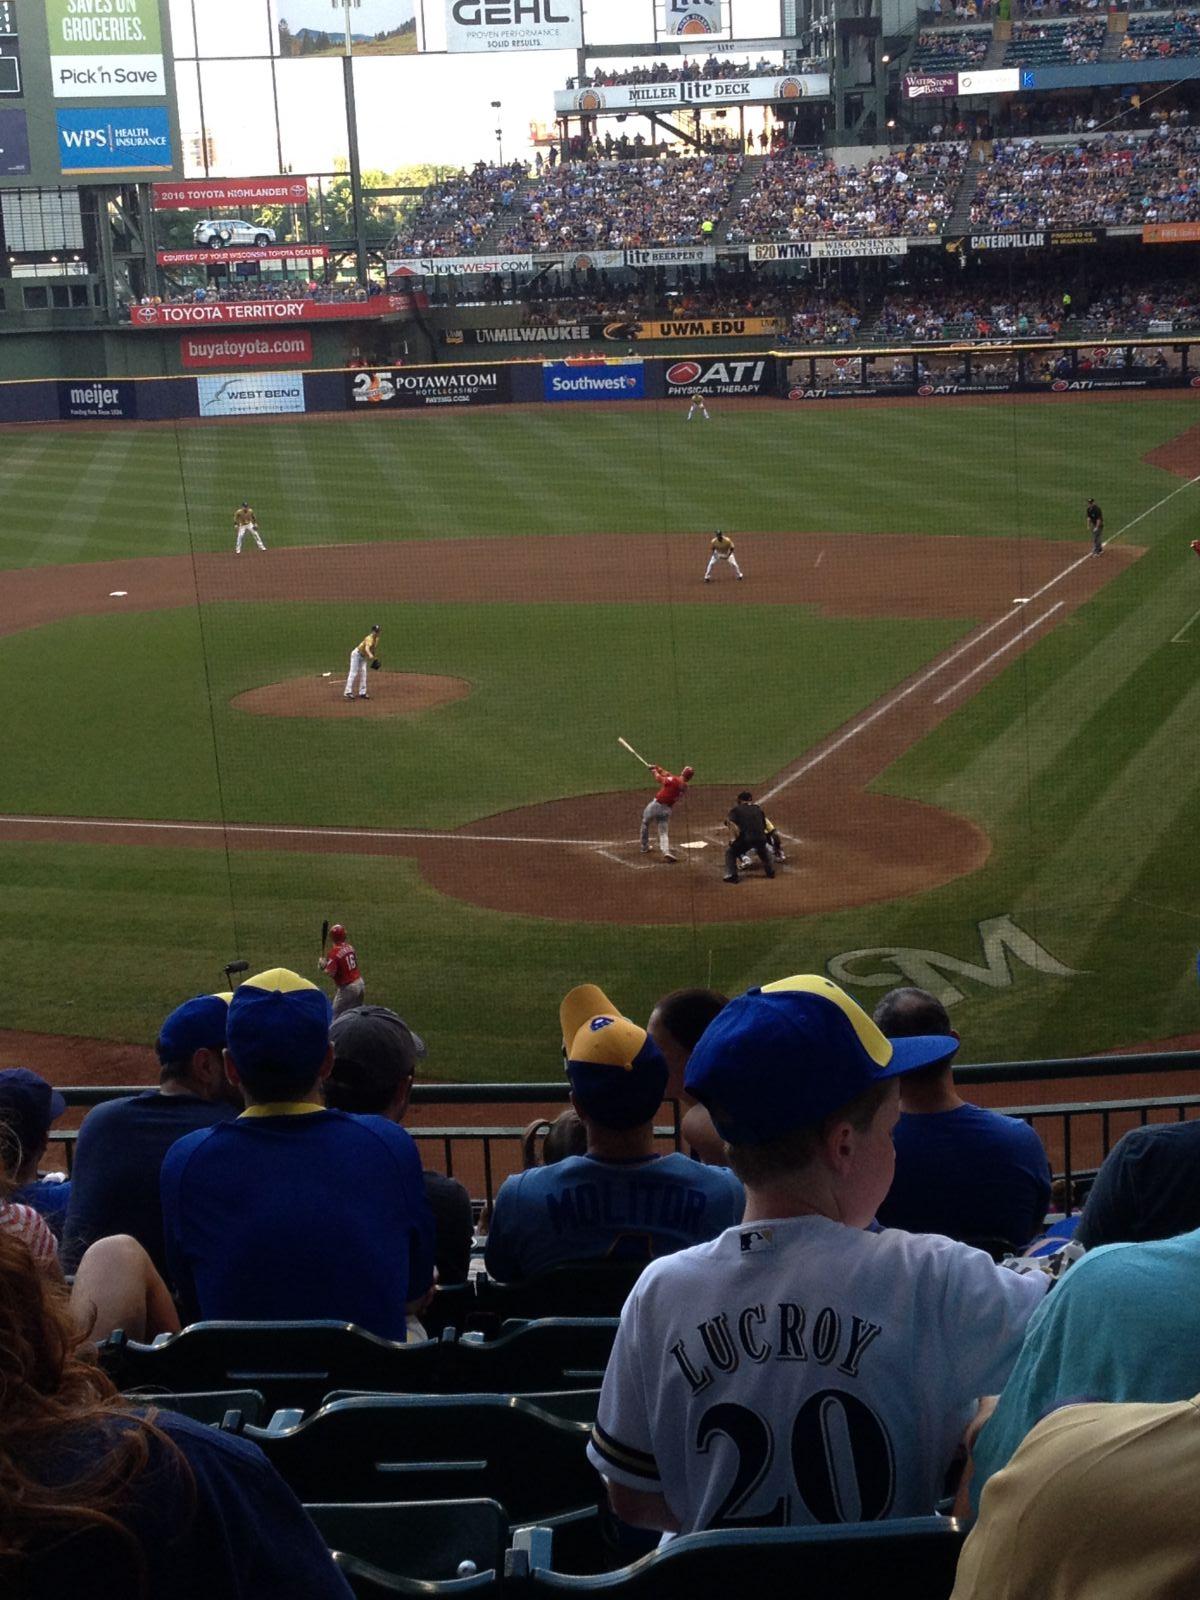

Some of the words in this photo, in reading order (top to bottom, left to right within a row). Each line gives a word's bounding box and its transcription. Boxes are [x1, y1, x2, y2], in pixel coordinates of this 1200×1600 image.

[452, 0, 570, 25] GEHL
[62, 17, 147, 41] GROCERIES.
[466, 31, 499, 39] PROVEN
[501, 28, 560, 37] PERFORMANCE
[487, 39, 509, 48] SOLID
[60, 69, 97, 84] Pick
[114, 68, 158, 83] Save
[629, 88, 677, 100] MILLER
[714, 83, 751, 96] DECK
[62, 129, 107, 148] WPS
[114, 127, 149, 138] HEALTH
[116, 136, 167, 147] INSURANCE
[161, 191, 185, 200] 2016
[187, 189, 225, 199] TOYOTA
[227, 187, 288, 197] HIGHLANDER
[824, 239, 895, 249] WISCONSIN'S
[971, 233, 1045, 249] CATERPILLAR
[163, 253, 199, 262] COURTESY
[652, 250, 696, 261] BEERPEN
[755, 245, 776, 259] 620
[777, 243, 812, 259] WTMJ
[818, 248, 851, 257] RADIO
[853, 245, 901, 256] STATION
[161, 306, 223, 321] TOYOTA
[225, 303, 304, 318] TERRITORY
[660, 320, 745, 336] UWM.EDU
[188, 339, 305, 359] buyatoyota.com
[699, 361, 765, 383] ATI
[396, 373, 497, 389] POTAWATOMI
[552, 376, 626, 391] Southwest
[1069, 380, 1094, 390] ATI
[70, 383, 119, 408] meijer
[227, 391, 262, 399] WEST
[264, 389, 300, 398] BEND
[668, 386, 714, 395] PHYSICAL
[716, 384, 760, 393] THERAPY
[546, 1182, 707, 1236] MOLITOR
[670, 1303, 882, 1397] LUCROY
[695, 1388, 897, 1526] 20
